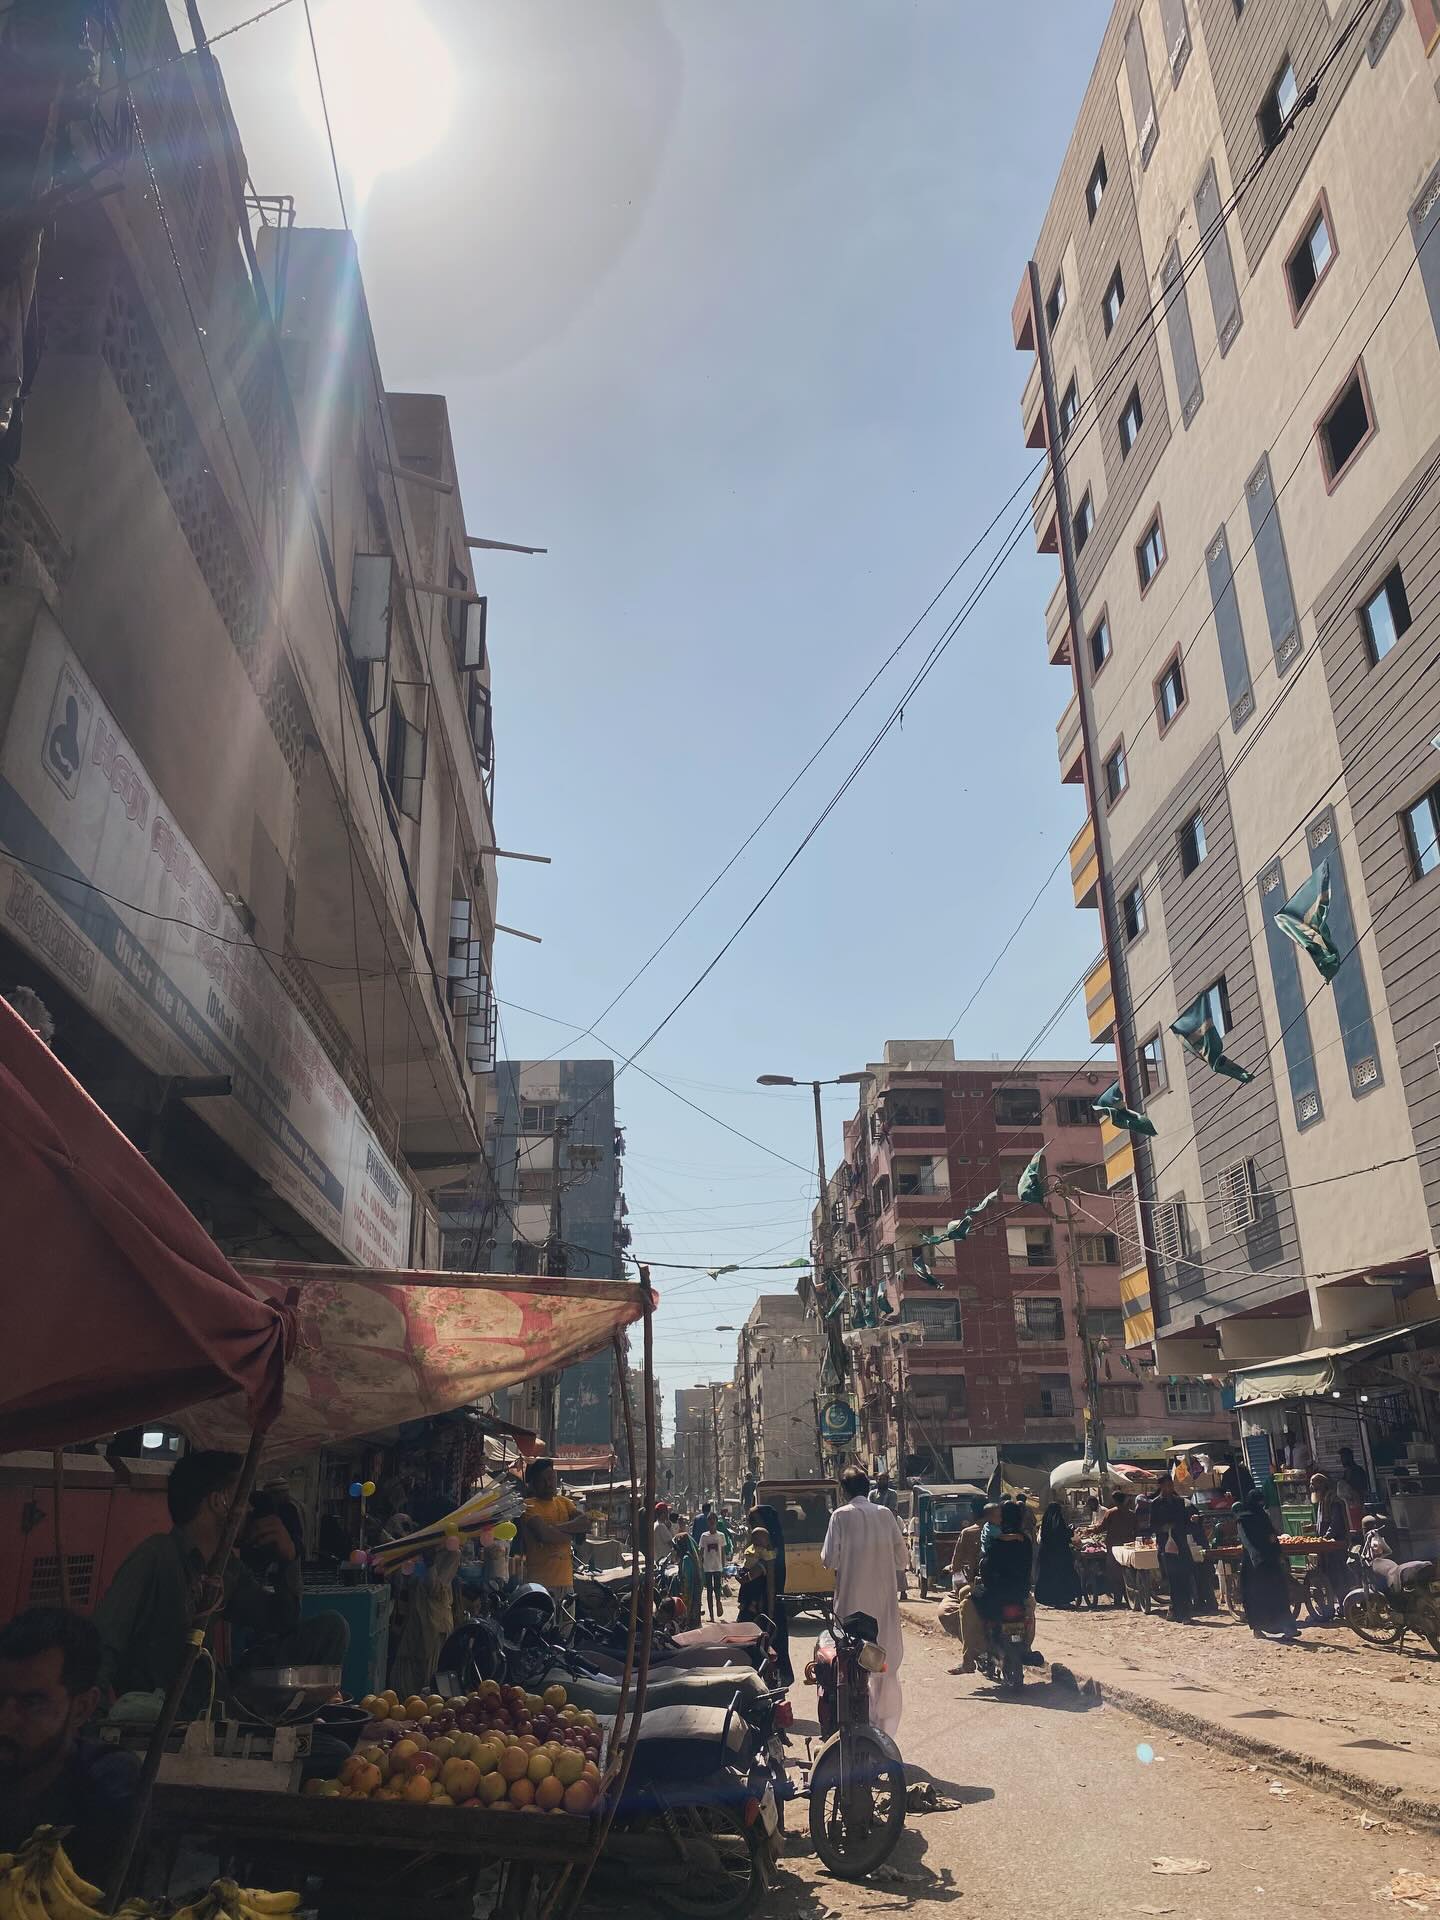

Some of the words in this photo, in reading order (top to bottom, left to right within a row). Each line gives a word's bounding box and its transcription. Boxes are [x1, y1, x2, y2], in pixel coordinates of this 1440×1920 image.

[92, 718, 150, 831] HAJI
[115, 928, 152, 989] Under
[155, 976, 173, 1013] the
